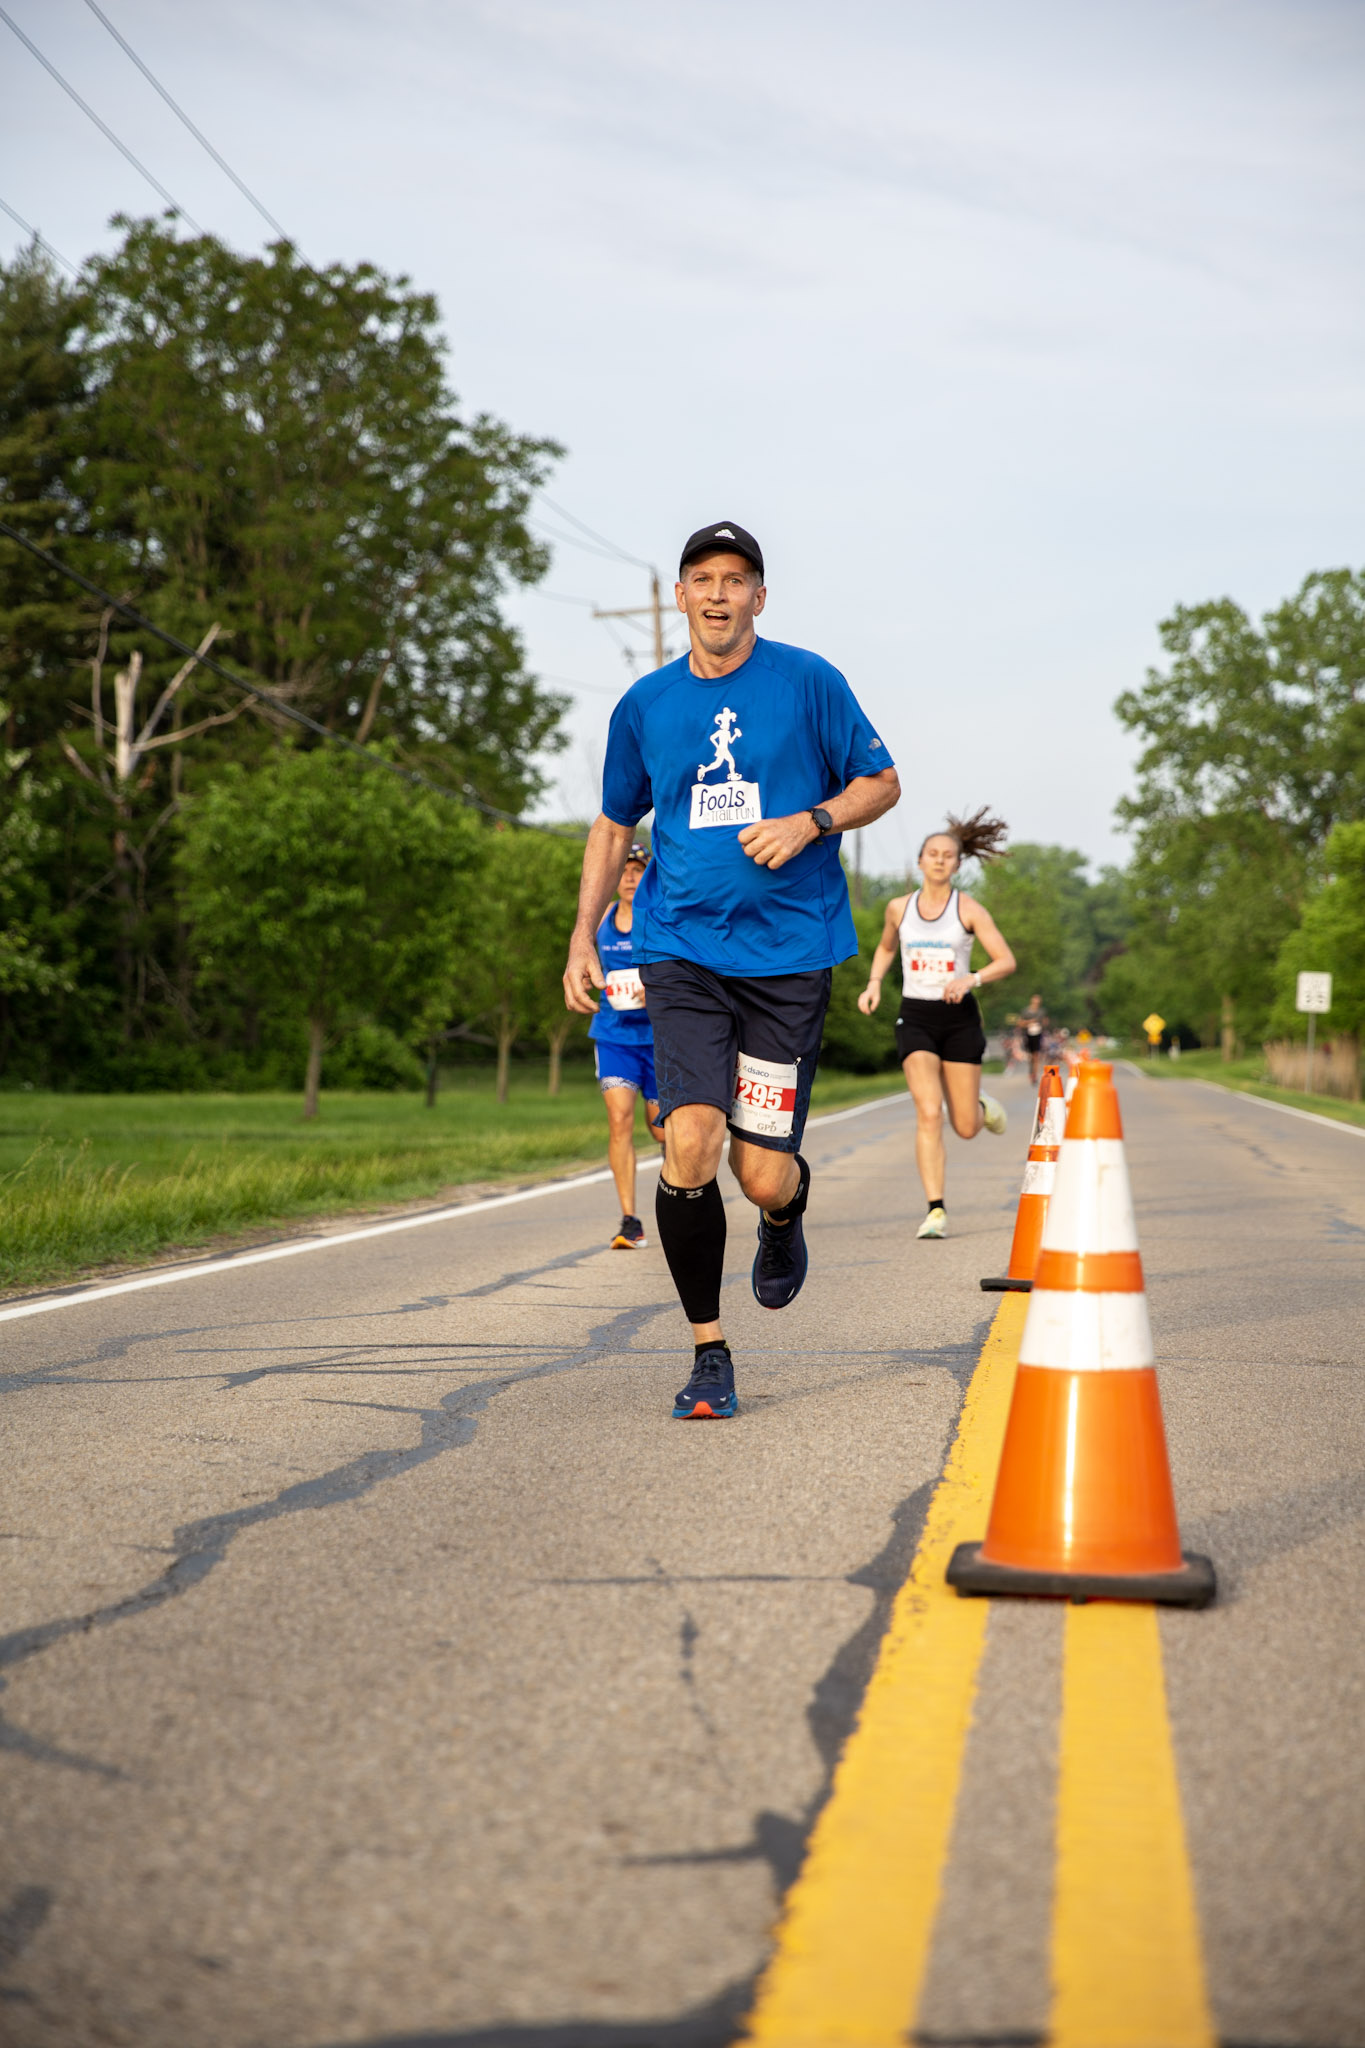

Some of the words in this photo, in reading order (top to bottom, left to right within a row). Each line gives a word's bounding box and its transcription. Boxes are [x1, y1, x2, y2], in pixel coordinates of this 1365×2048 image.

[699, 787, 745, 817] fools
[747, 1066, 770, 1078] dsaco
[737, 1079, 783, 1110] 295
[757, 1123, 777, 1132] GPD
